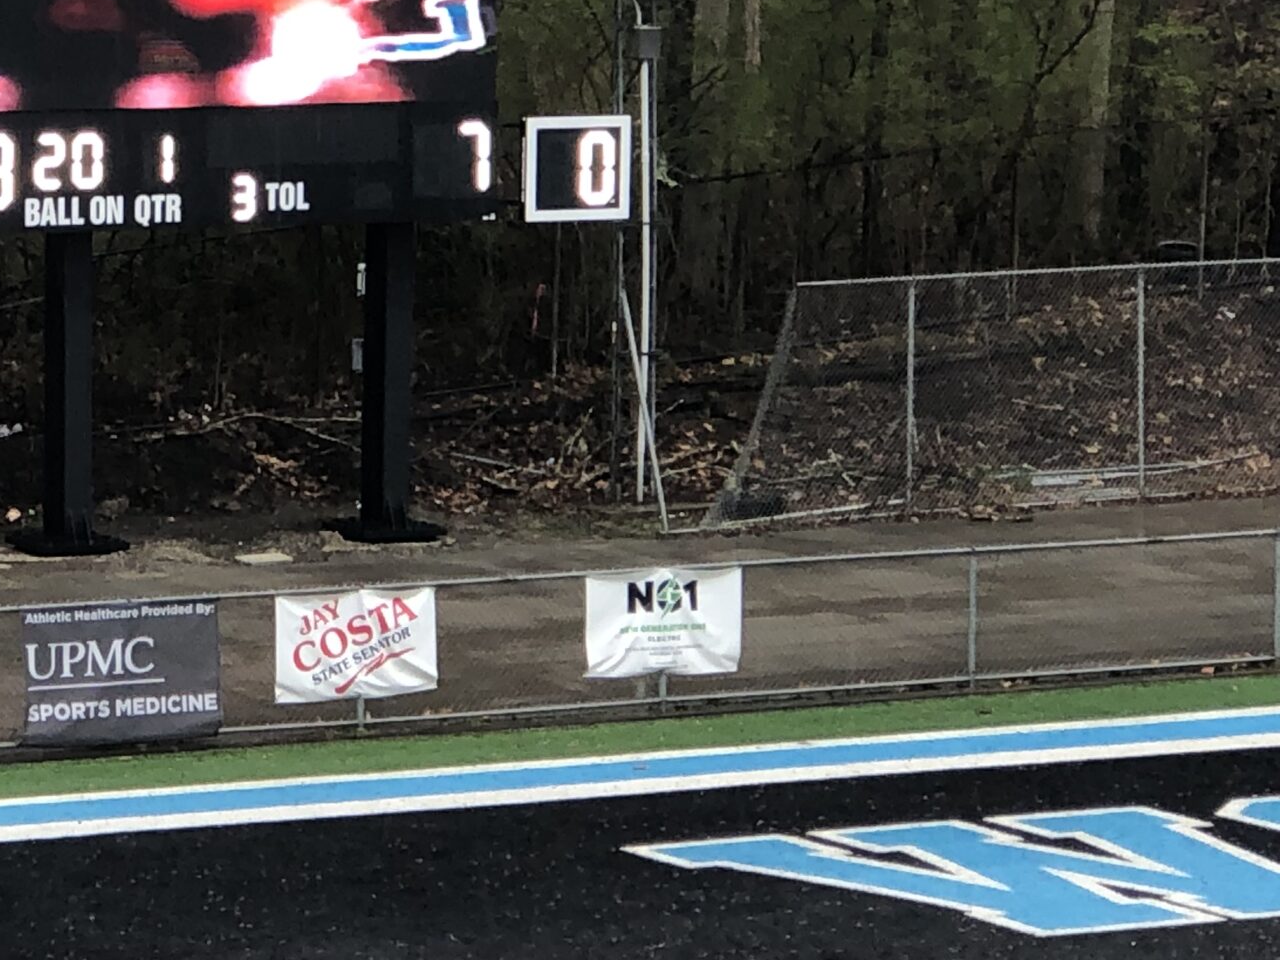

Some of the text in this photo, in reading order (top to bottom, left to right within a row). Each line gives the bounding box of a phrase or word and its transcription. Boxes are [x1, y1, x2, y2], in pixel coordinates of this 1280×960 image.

[33, 133, 105, 191] 20
[160, 134, 175, 183] 1
[459, 120, 491, 192] 7
[579, 129, 616, 206] 0
[25, 195, 124, 228] BALL ON
[134, 194, 181, 227] QTR
[231, 174, 257, 222] 3
[266, 182, 310, 212] TOL
[25, 603, 215, 624] Athletic Healthcare Provided By:
[293, 597, 418, 672] COSTA
[298, 599, 340, 636] JAY
[25, 636, 154, 680] UPMC
[312, 626, 412, 686] STATE SENATOR
[27, 693, 218, 722] SPORTS MEDICINE
